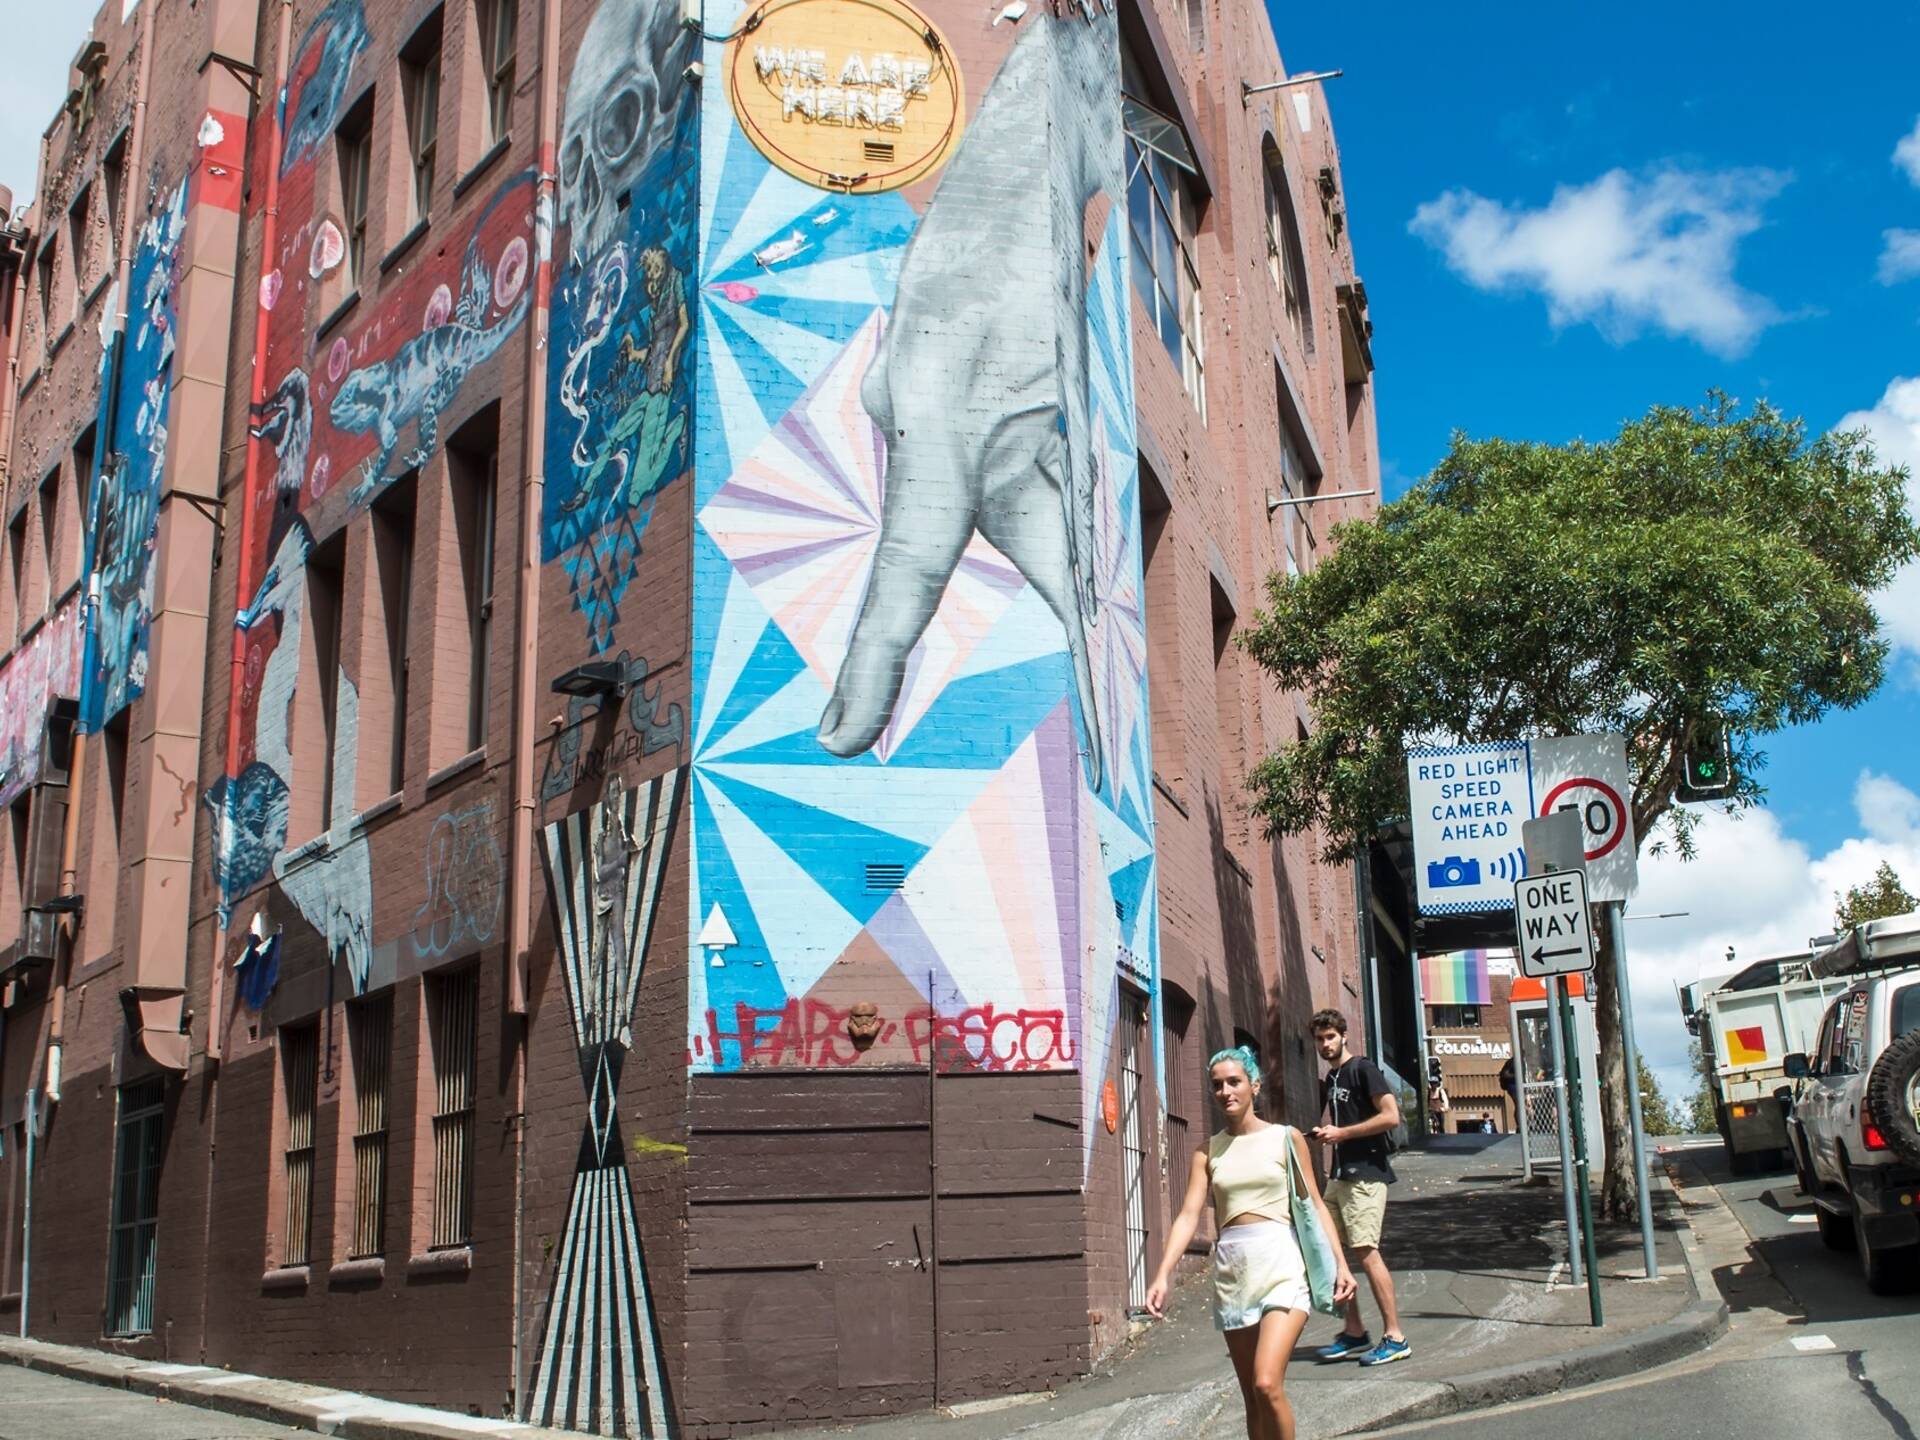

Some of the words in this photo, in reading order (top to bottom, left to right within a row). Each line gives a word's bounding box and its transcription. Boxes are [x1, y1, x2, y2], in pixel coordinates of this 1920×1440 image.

[1418, 763, 1455, 780] RED
[1466, 758, 1520, 777] LIGHT
[1441, 780, 1501, 799] SPEED
[1432, 800, 1513, 820] CAMERA
[1558, 800, 1611, 835] 0
[1441, 821, 1508, 841] AHEAD
[1526, 882, 1575, 909] ONE
[1526, 912, 1579, 940] WAY
